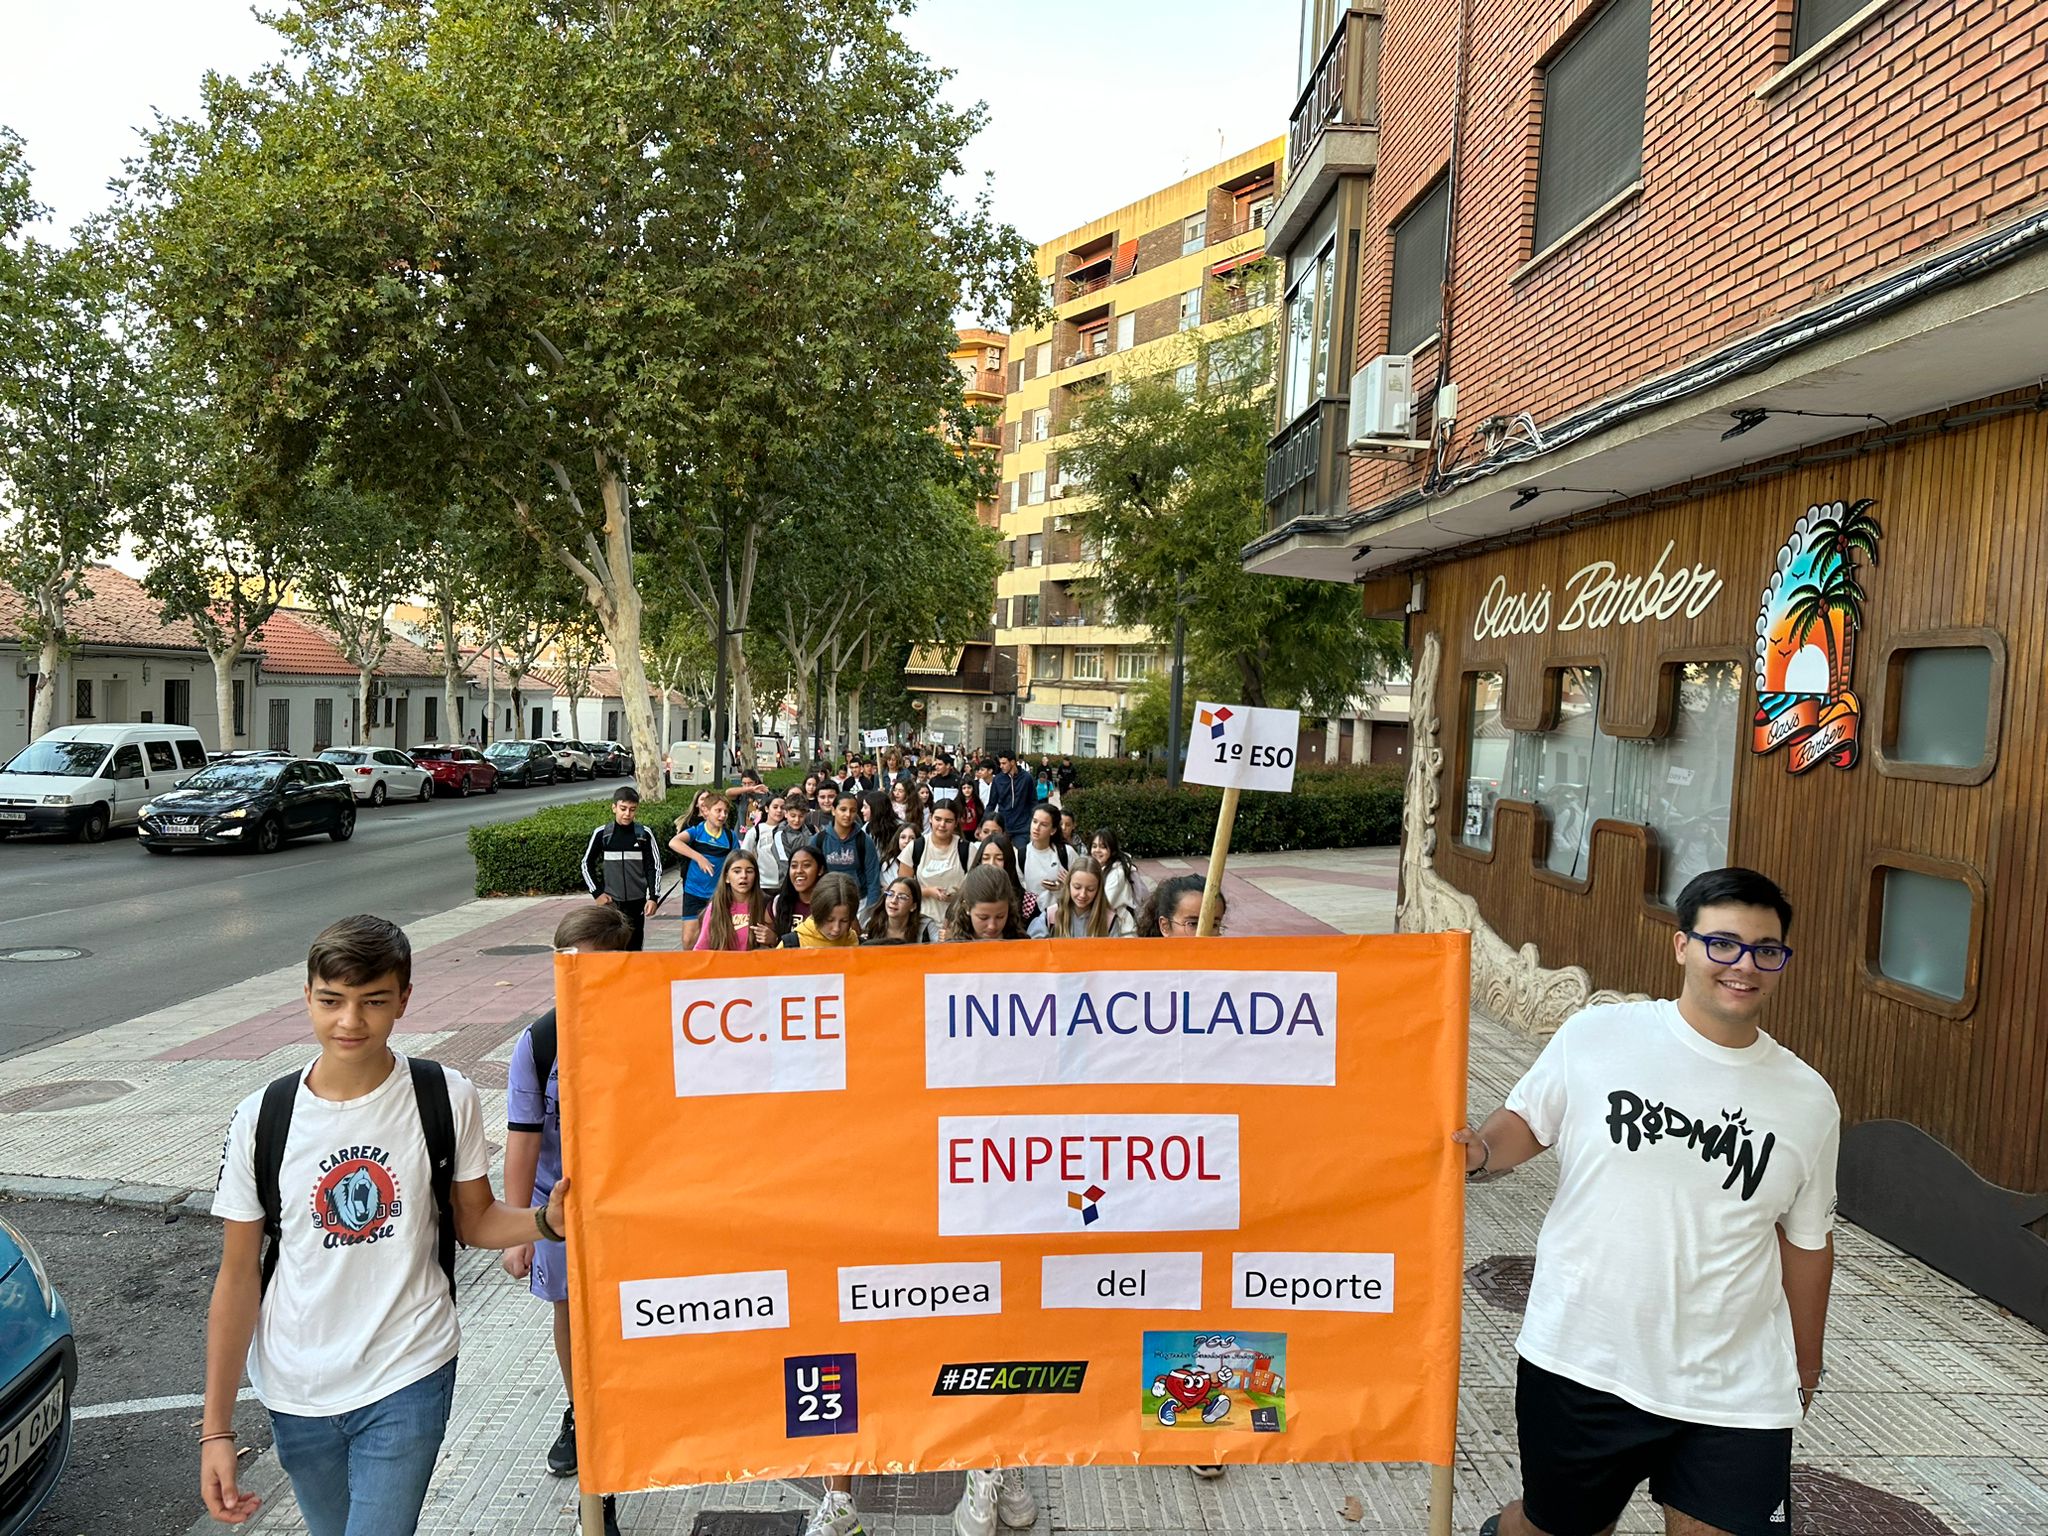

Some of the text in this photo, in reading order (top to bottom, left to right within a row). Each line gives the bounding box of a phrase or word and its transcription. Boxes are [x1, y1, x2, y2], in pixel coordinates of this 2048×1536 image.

[1474, 539, 1724, 641] Oasis Barber
[1766, 713, 1800, 745] Oasis
[1795, 724, 1847, 769] Barber
[1214, 742, 1294, 769] 1º ESO
[682, 991, 1325, 1045] CC.EE INMACULADA
[319, 1145, 390, 1173] CARRERA
[949, 1135, 1221, 1184] ENPETROL
[1605, 1089, 1776, 1202] RODMAN
[635, 1270, 1383, 1327] Semana Europea del Deporte
[941, 1363, 1080, 1392] #BEACTIVE
[797, 1393, 843, 1422] 23
